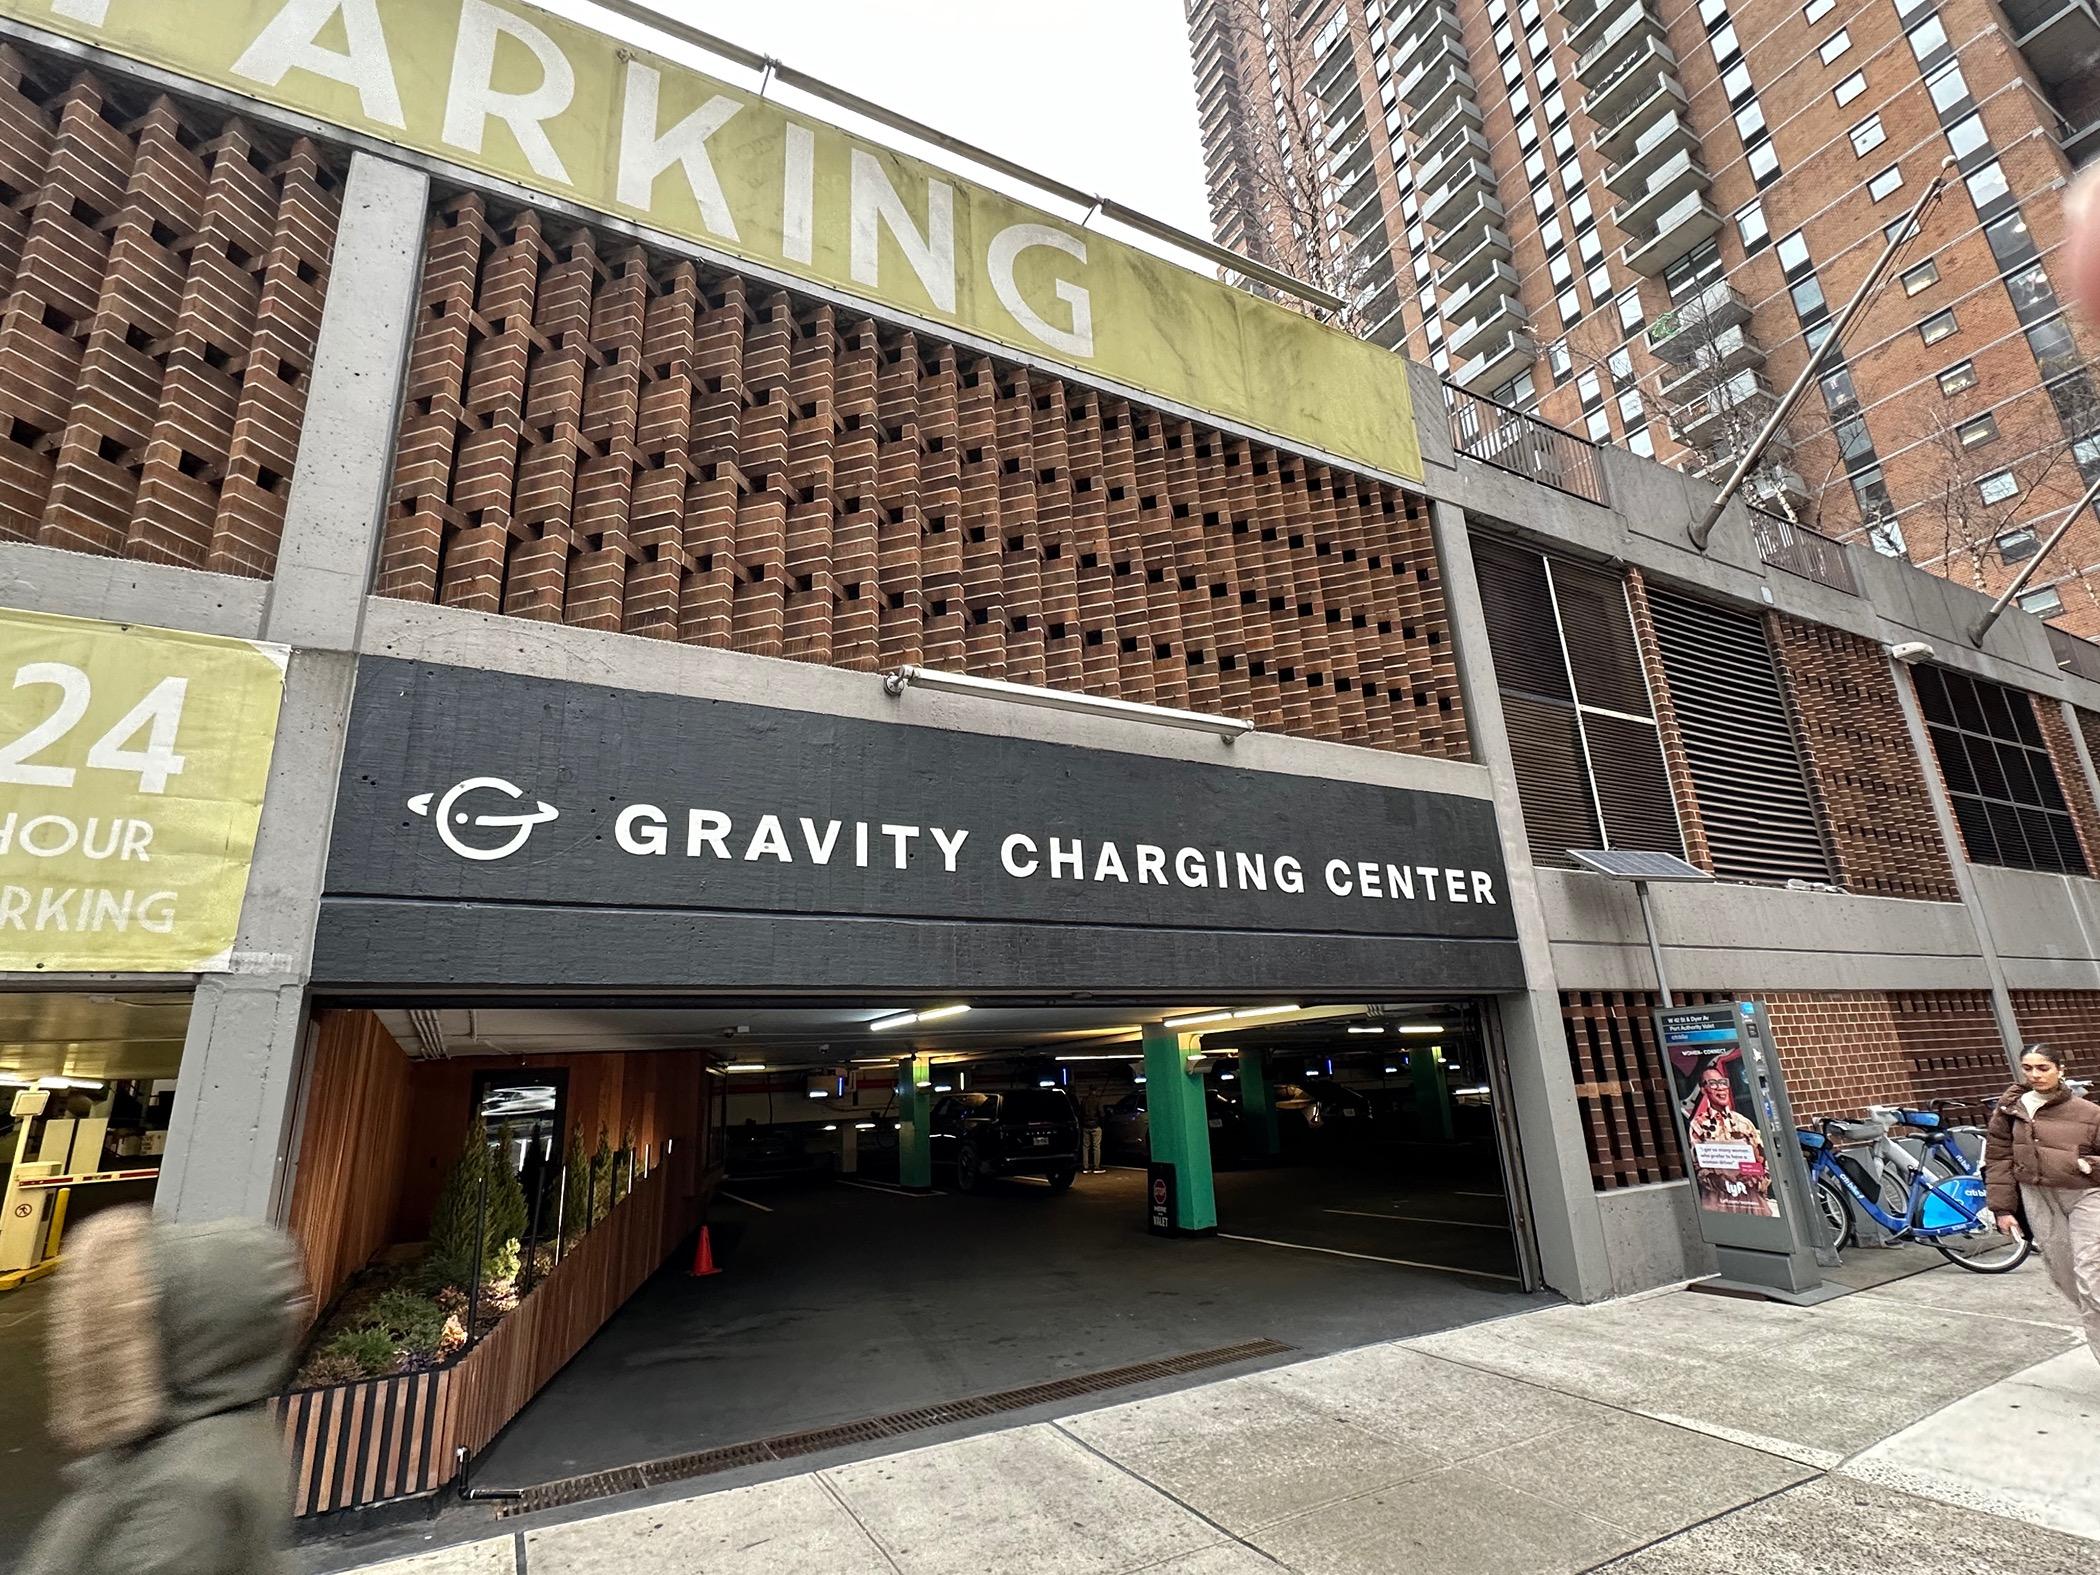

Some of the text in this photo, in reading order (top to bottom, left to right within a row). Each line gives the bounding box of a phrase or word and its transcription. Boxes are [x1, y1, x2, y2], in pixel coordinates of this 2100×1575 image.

[50, 0, 1094, 358] ARKING
[0, 662, 188, 794] 24
[614, 803, 1496, 904] GRAVITY CHARGING CENTER
